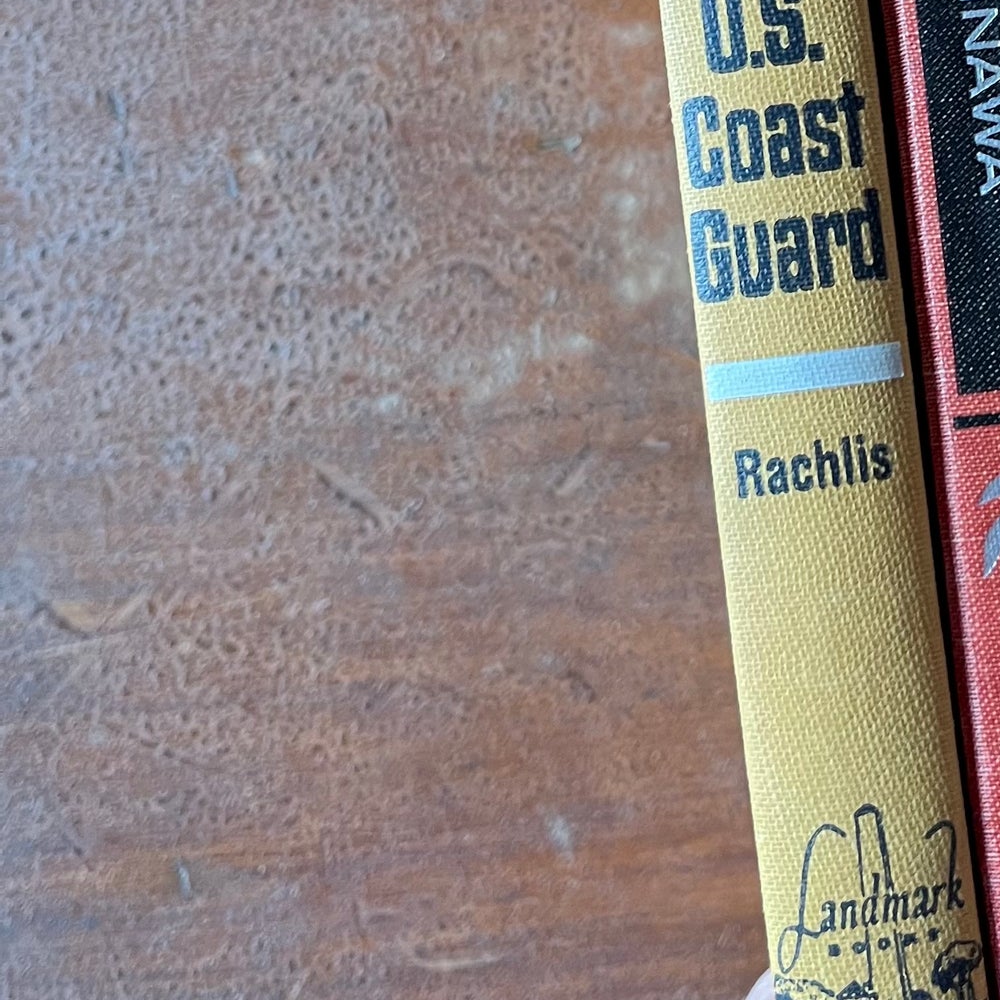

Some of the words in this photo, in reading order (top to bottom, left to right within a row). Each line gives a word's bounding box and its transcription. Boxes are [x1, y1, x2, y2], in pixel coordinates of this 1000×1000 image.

[681, 81, 866, 189] Coast
[689, 188, 887, 303] Guard
[735, 434, 893, 499] Rachlis
[779, 820, 964, 974] Landmark
